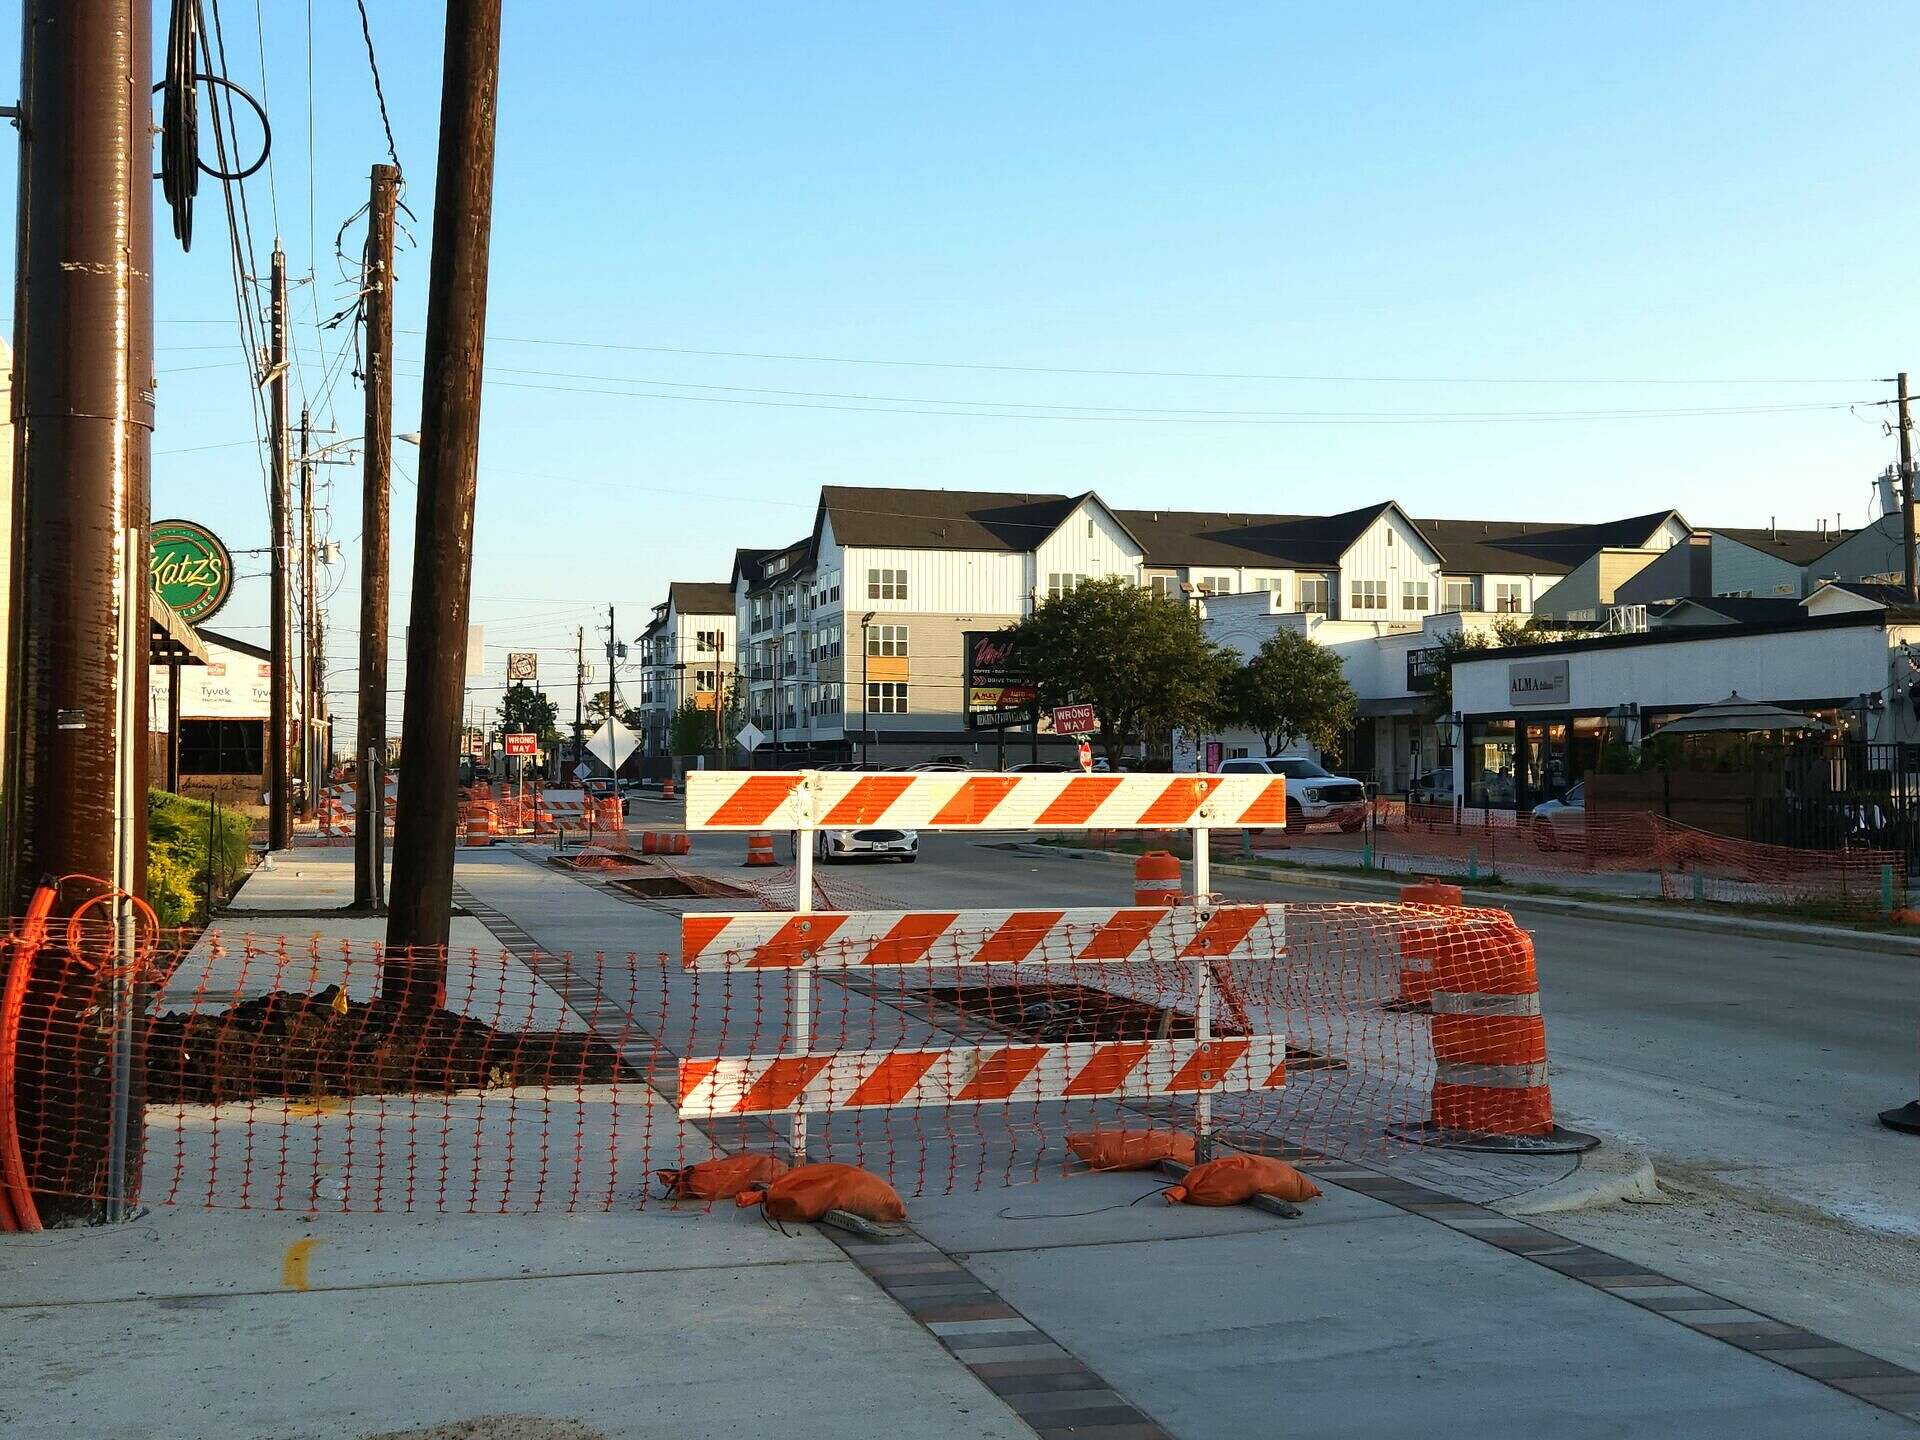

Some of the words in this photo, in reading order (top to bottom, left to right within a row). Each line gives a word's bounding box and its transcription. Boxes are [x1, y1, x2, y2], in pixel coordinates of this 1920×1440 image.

[150, 551, 222, 594] Katz's
[1511, 677, 1540, 692] ALMA
[151, 686, 170, 695] Tyv
[201, 686, 231, 697] Tyvek
[252, 688, 271, 699] Tyv
[1057, 708, 1090, 721] WRONG
[1063, 720, 1086, 731] WAY
[508, 736, 535, 744] WRONG
